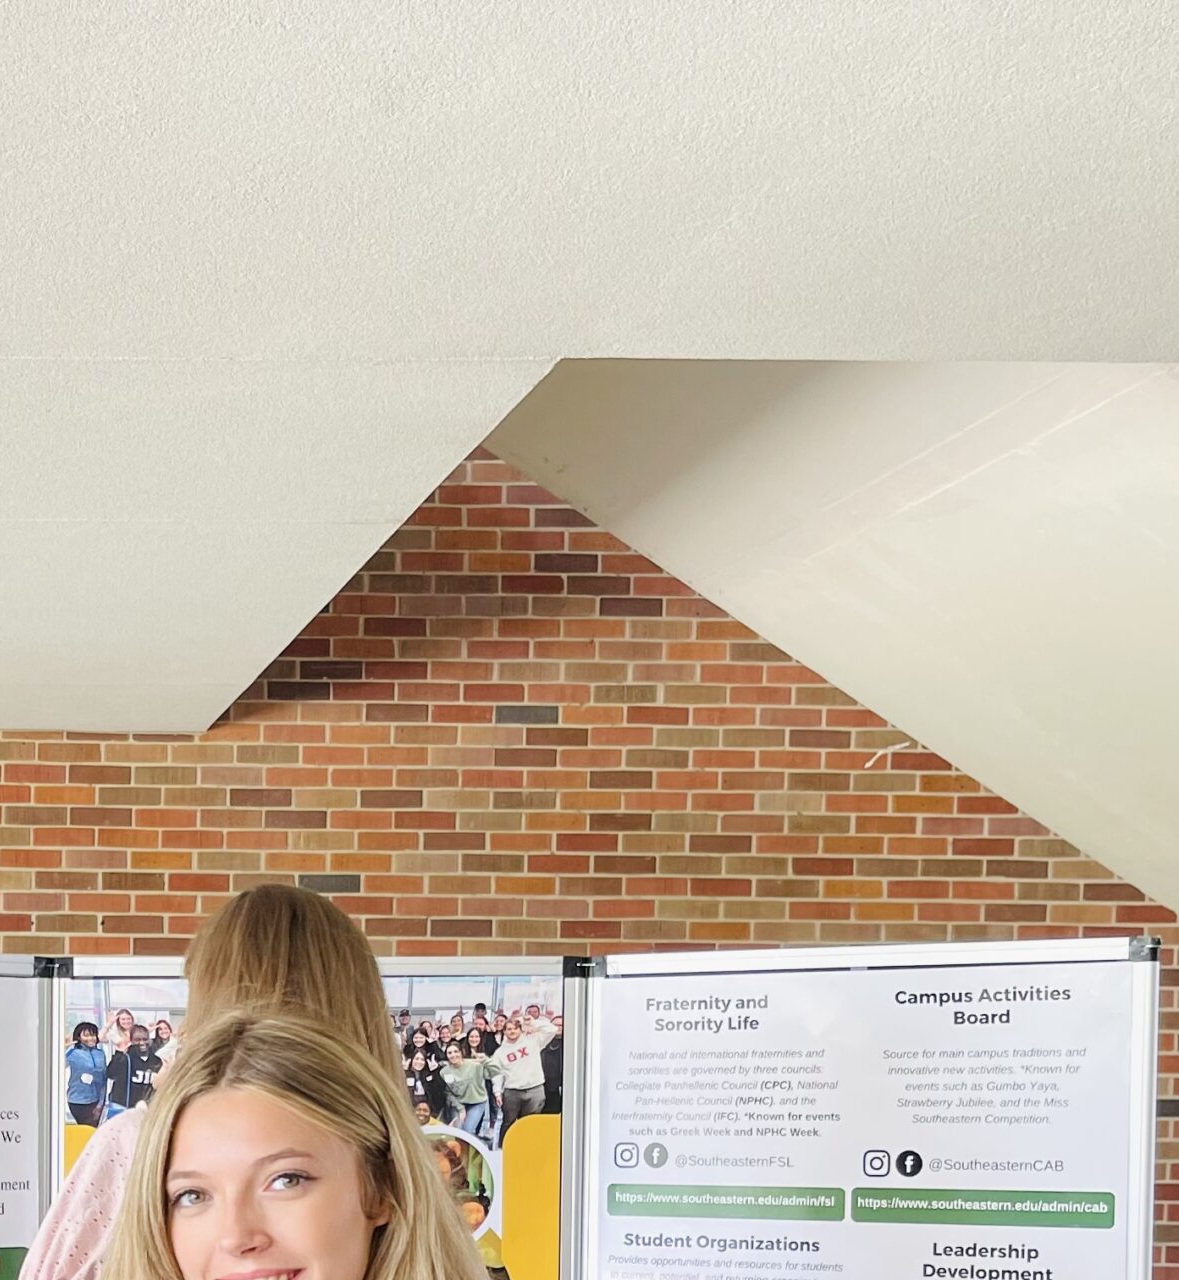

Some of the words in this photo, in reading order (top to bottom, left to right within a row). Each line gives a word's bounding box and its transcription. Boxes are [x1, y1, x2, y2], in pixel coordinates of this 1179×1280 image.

[645, 994, 732, 1013] Fraternity
[734, 994, 768, 1010] and
[894, 990, 973, 1007] Campus
[977, 985, 1071, 1003] Activities
[654, 1015, 724, 1034] Sorority
[727, 1014, 760, 1031] Life
[953, 1008, 1010, 1025] Board
[882, 1048, 919, 1060] Source
[921, 1048, 936, 1059] for
[938, 1049, 965, 1059] main
[966, 1049, 1009, 1060] campus
[1011, 1047, 1062, 1058] traditions
[1064, 1047, 1087, 1057] and
[886, 1066, 941, 1075] innovative
[942, 1066, 966, 1075] new
[1064, 1063, 1081, 1074] for
[904, 1082, 940, 1092] events
[942, 1080, 968, 1091] such
[969, 1082, 984, 1091] as
[985, 1080, 1026, 1092] Gumbo
[896, 1097, 954, 1110] Strawberry
[999, 1097, 1021, 1108] and
[1023, 1097, 1041, 1107] the
[1043, 1097, 1069, 1107] Miss
[911, 1113, 982, 1124] Southeastern
[1, 1130, 22, 1144] We
[674, 1153, 793, 1169] @SoutheasternFSL
[928, 1157, 1064, 1173] @SoutheasternCAB
[615, 1191, 835, 1207] https://www.southeastern.edu/admin/fsl
[856, 1195, 1108, 1213] https://www.southeastern.edu/admin/cab
[623, 1232, 693, 1248] Student
[695, 1234, 820, 1253] Organizations
[932, 1241, 1039, 1263] Leadership
